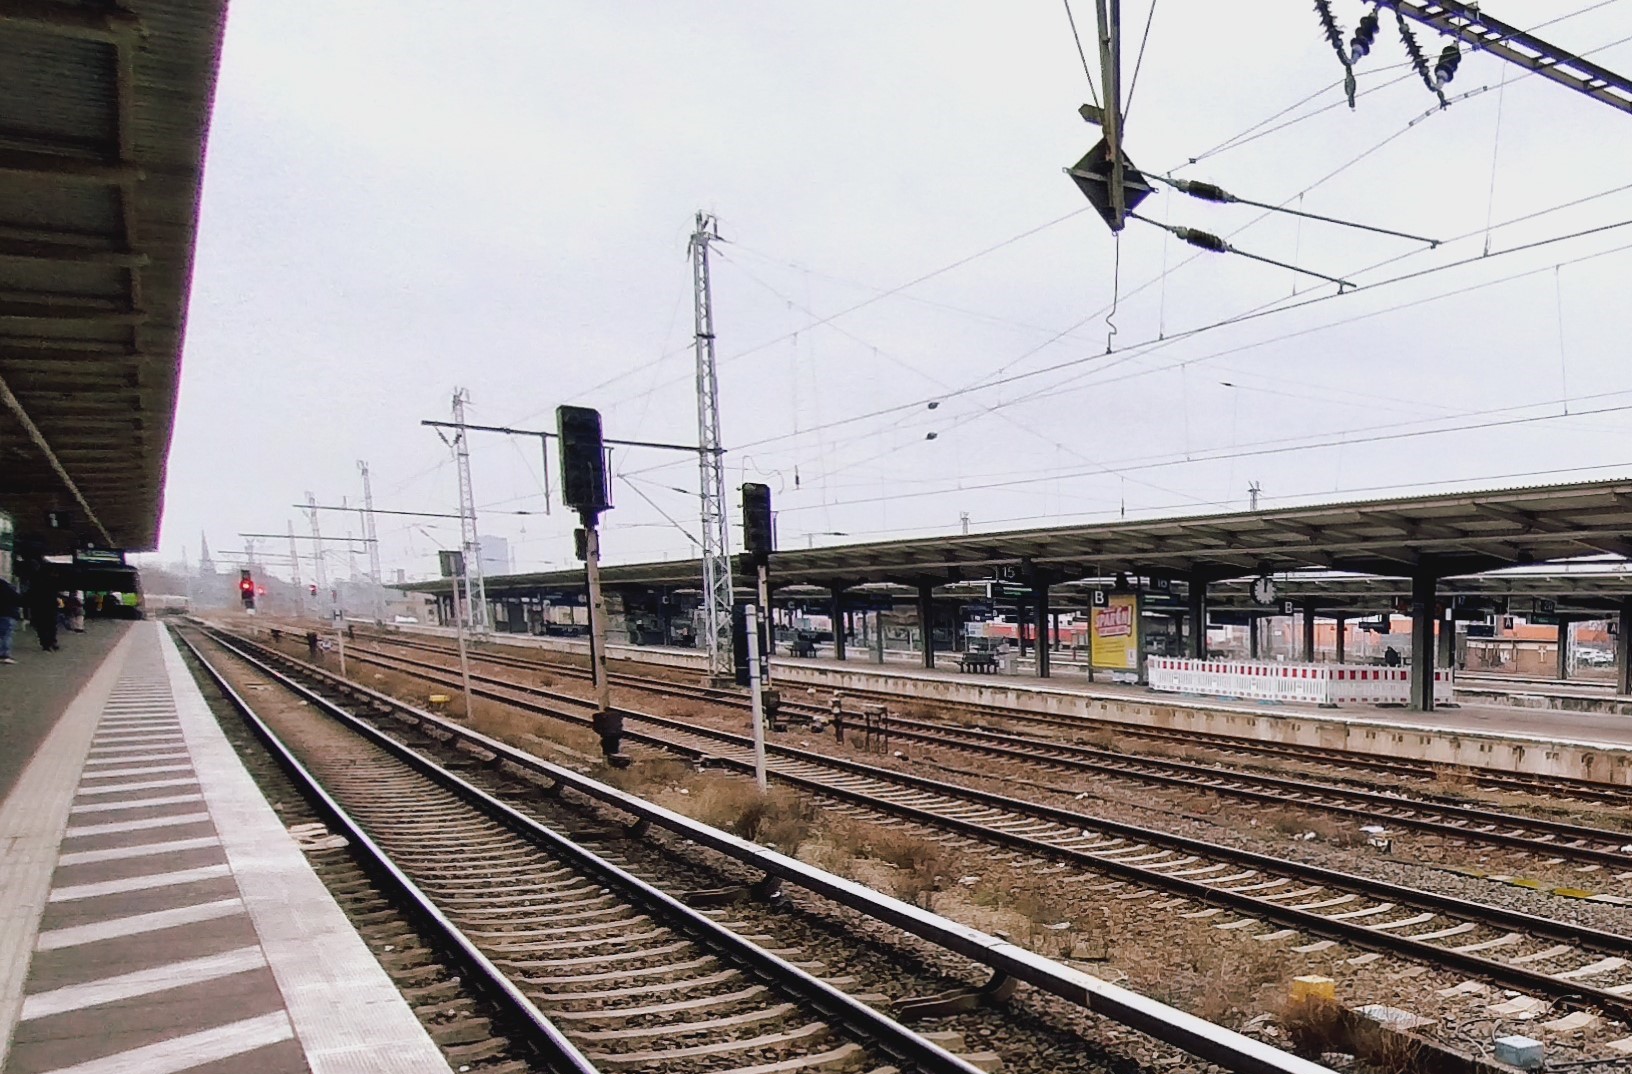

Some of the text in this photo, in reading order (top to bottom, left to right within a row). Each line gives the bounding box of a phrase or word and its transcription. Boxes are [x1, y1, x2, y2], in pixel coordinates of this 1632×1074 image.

[1002, 566, 1016, 578] 15
[1095, 590, 1104, 604] B
[1285, 601, 1293, 613] B
[333, 609, 343, 621] H
[1505, 618, 1512, 628] A
